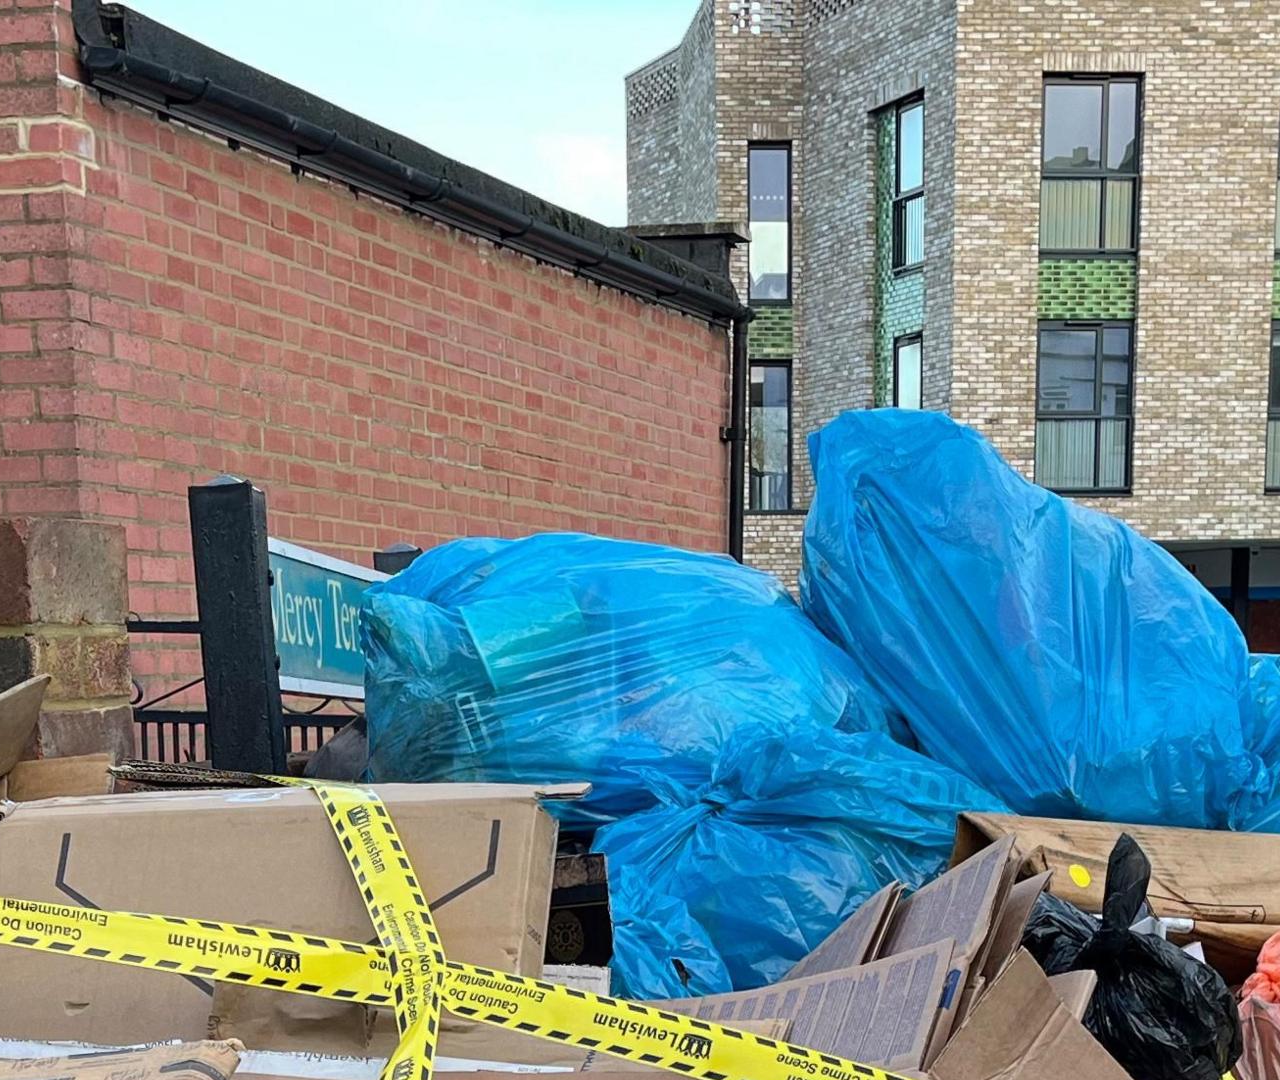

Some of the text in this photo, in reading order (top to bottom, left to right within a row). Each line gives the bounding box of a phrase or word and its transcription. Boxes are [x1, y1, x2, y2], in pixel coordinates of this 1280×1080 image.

[357, 823, 386, 874] Lewisham
[0, 915, 20, 930] Do
[1, 898, 108, 926] Environmental
[24, 918, 82, 940] Caution
[402, 910, 424, 941] Caution
[417, 953, 432, 975] Not
[167, 933, 262, 964] Lewisham
[398, 957, 418, 995] Crime
[453, 972, 545, 1003] Environmental
[406, 996, 419, 1024] Scen
[446, 986, 519, 1015] Caution Do
[592, 1011, 678, 1048] Lewisham
[775, 1052, 818, 1075] Scene
